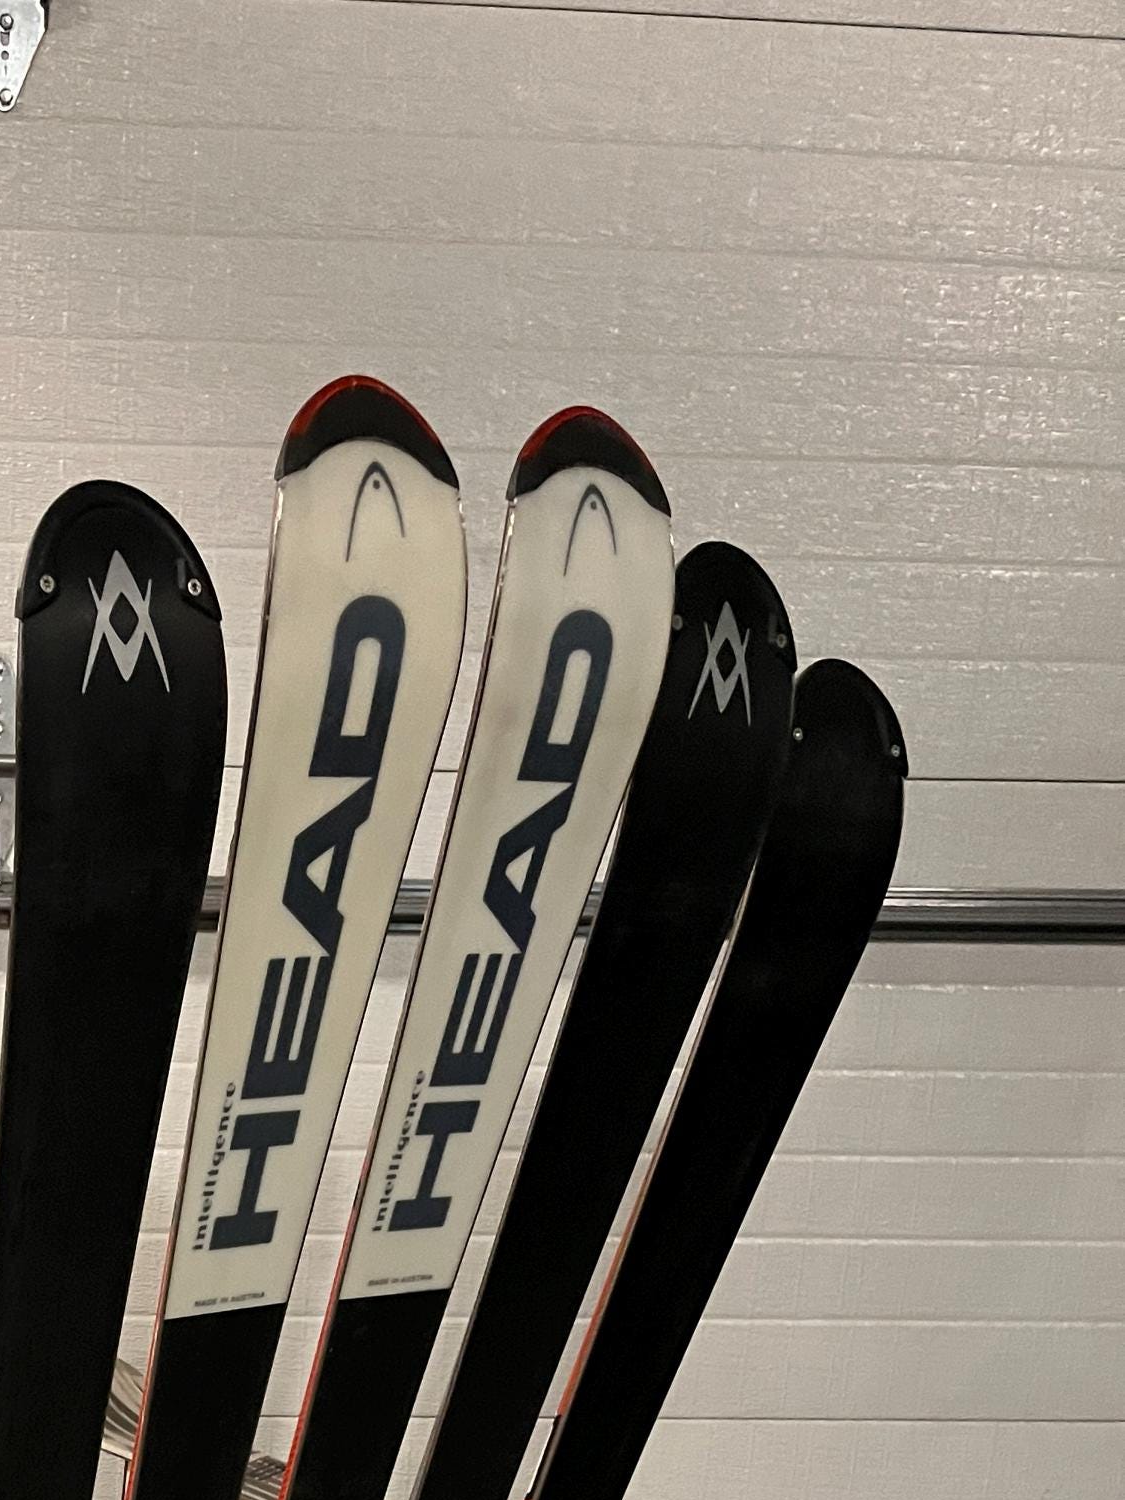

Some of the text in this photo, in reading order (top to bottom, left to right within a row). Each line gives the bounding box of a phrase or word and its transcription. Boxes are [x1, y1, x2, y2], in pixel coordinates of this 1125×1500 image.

[209, 595, 405, 1250] HEAD
[387, 610, 613, 1233] HEAD
[192, 1081, 236, 1251] intelligence
[372, 1069, 426, 1232] intelligence
